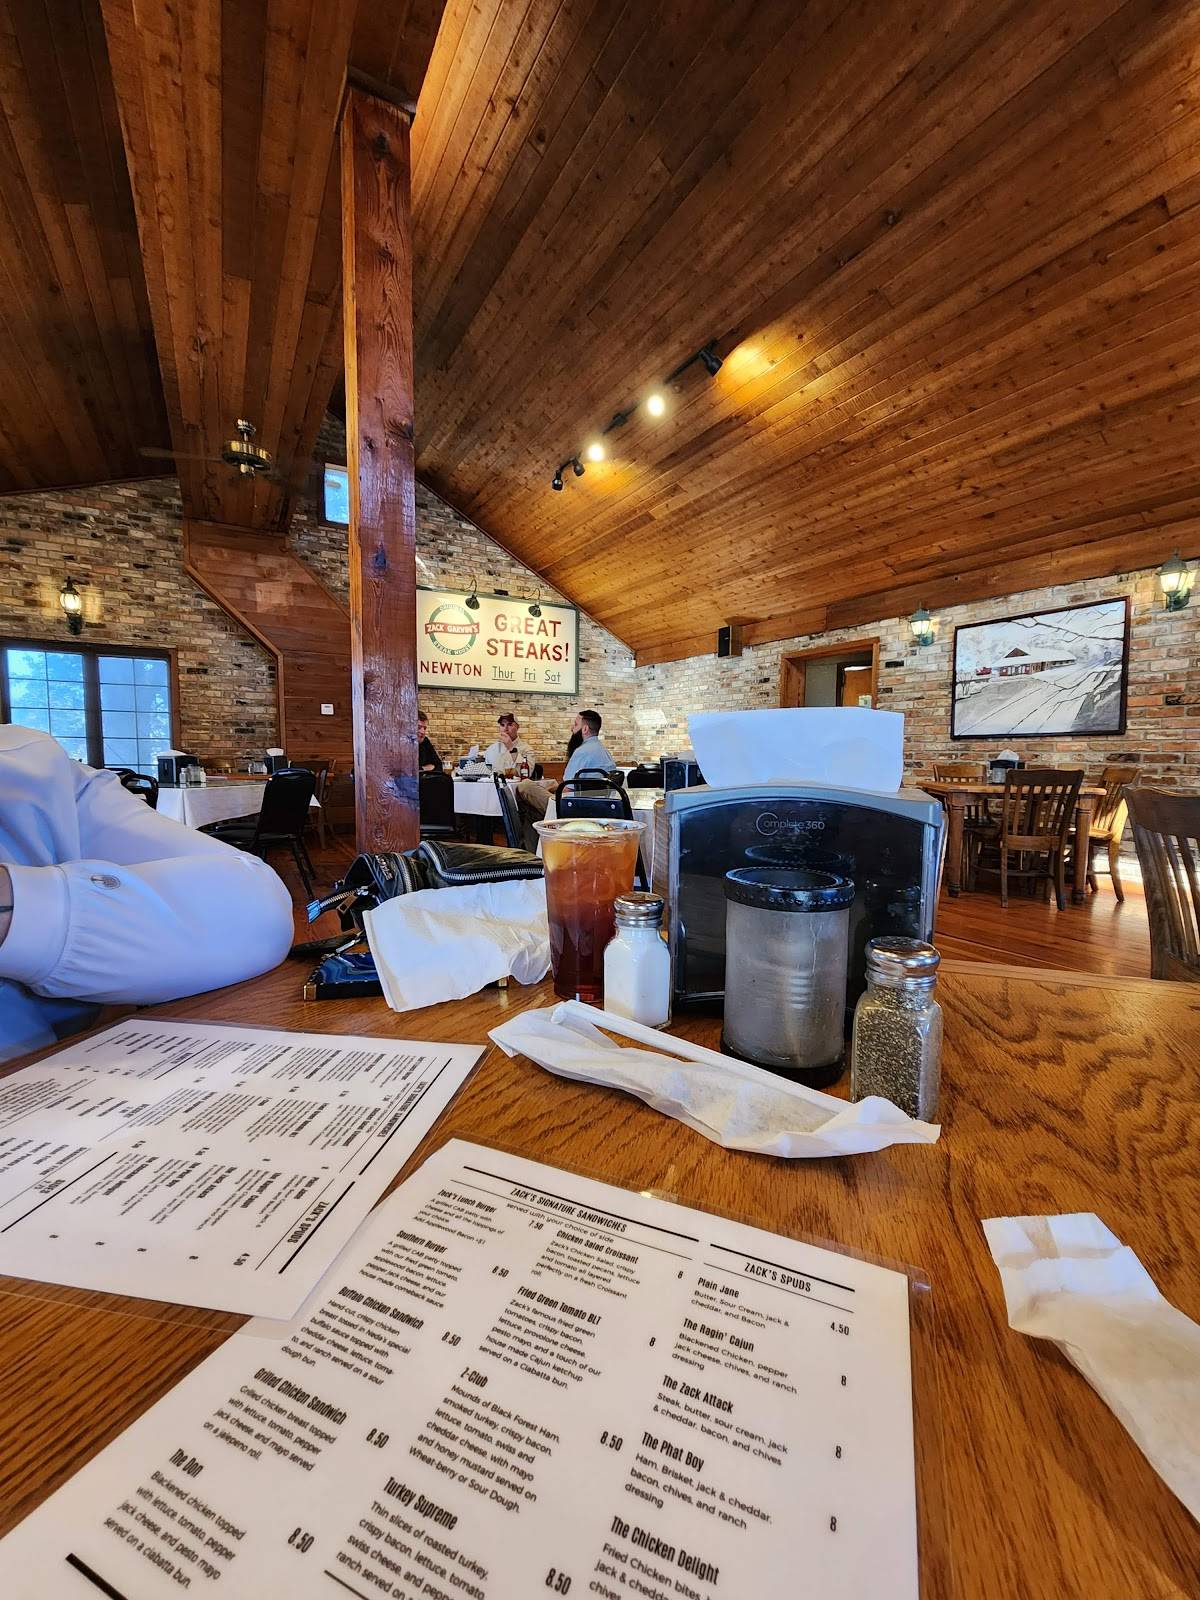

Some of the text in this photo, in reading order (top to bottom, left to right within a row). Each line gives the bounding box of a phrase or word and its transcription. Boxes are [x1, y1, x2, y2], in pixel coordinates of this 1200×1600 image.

[427, 624, 478, 634] ZACK GARVIN'S
[494, 613, 562, 638] GREAT
[486, 638, 569, 662] STEAKS!
[420, 660, 482, 677] NEWTON
[492, 666, 561, 682] Thur Fri Sat
[286, 1200, 330, 1244] ZACK'S SPUDS
[505, 1202, 530, 1214] served
[528, 1210, 546, 1220] with
[545, 1216, 564, 1226] your
[563, 1222, 589, 1235] choice
[598, 1234, 615, 1244] side
[509, 1187, 628, 1233] ZACK'S SIGNATURE SANDWICHES
[395, 1229, 448, 1254] Southern Burger
[555, 1229, 639, 1265] Chicken Salad Croissant
[491, 1265, 510, 1278] 8.50
[743, 1261, 811, 1293] ZACK'S SPUDS
[696, 1276, 740, 1299] Plain Jane
[337, 1285, 425, 1330] Buffalo Chicken Sandwich
[516, 1285, 602, 1326] Fried Green Tomato BLT
[718, 1298, 737, 1309] Sour
[764, 1314, 782, 1325] jack
[723, 1310, 740, 1320] and
[740, 1314, 766, 1329] Bacon
[440, 1330, 462, 1347] 8.50
[648, 1336, 656, 1347] 8
[682, 1317, 755, 1353] The Ragin' Cajun
[829, 1321, 850, 1336] 4.50
[671, 1352, 705, 1371] dressing
[673, 1341, 691, 1353] jack
[752, 1372, 770, 1384] and
[771, 1379, 798, 1394] ranch
[678, 1331, 720, 1353] Blackened
[756, 1362, 788, 1379] pepper
[459, 1366, 489, 1388] Z-Club
[840, 1374, 847, 1387] 8
[253, 1367, 348, 1426] Grilled Chicken Sandwich
[450, 1383, 481, 1405] Mounds
[480, 1400, 492, 1409] of
[489, 1402, 513, 1420] Black
[512, 1413, 539, 1432] Forest
[661, 1374, 734, 1414] The Zack Attack
[365, 1427, 390, 1449] 8.50
[599, 1430, 624, 1452] 8.50
[713, 1417, 734, 1430] sour
[766, 1439, 788, 1454] jack
[168, 1447, 204, 1478] The Don
[641, 1430, 705, 1473] The Phat Boy
[731, 1439, 751, 1453] and
[751, 1448, 782, 1466] chives
[834, 1444, 842, 1459] 8
[382, 1475, 458, 1531] Turkey Supreme
[623, 1482, 664, 1510] dressing
[694, 1480, 717, 1498] jack
[695, 1499, 716, 1515] and
[717, 1509, 747, 1530] ranch
[829, 1515, 838, 1533] 8
[287, 1526, 315, 1554] 8.50
[370, 1500, 390, 1519] Thin
[388, 1514, 414, 1534] slices
[412, 1528, 426, 1540] of
[422, 1534, 460, 1561] roasted
[610, 1514, 720, 1586] The Chicken Delight
[594, 1559, 627, 1584] jack &
[602, 1542, 628, 1564] Fried
[630, 1557, 672, 1587] Chicken
[544, 1567, 572, 1596] 8.50
